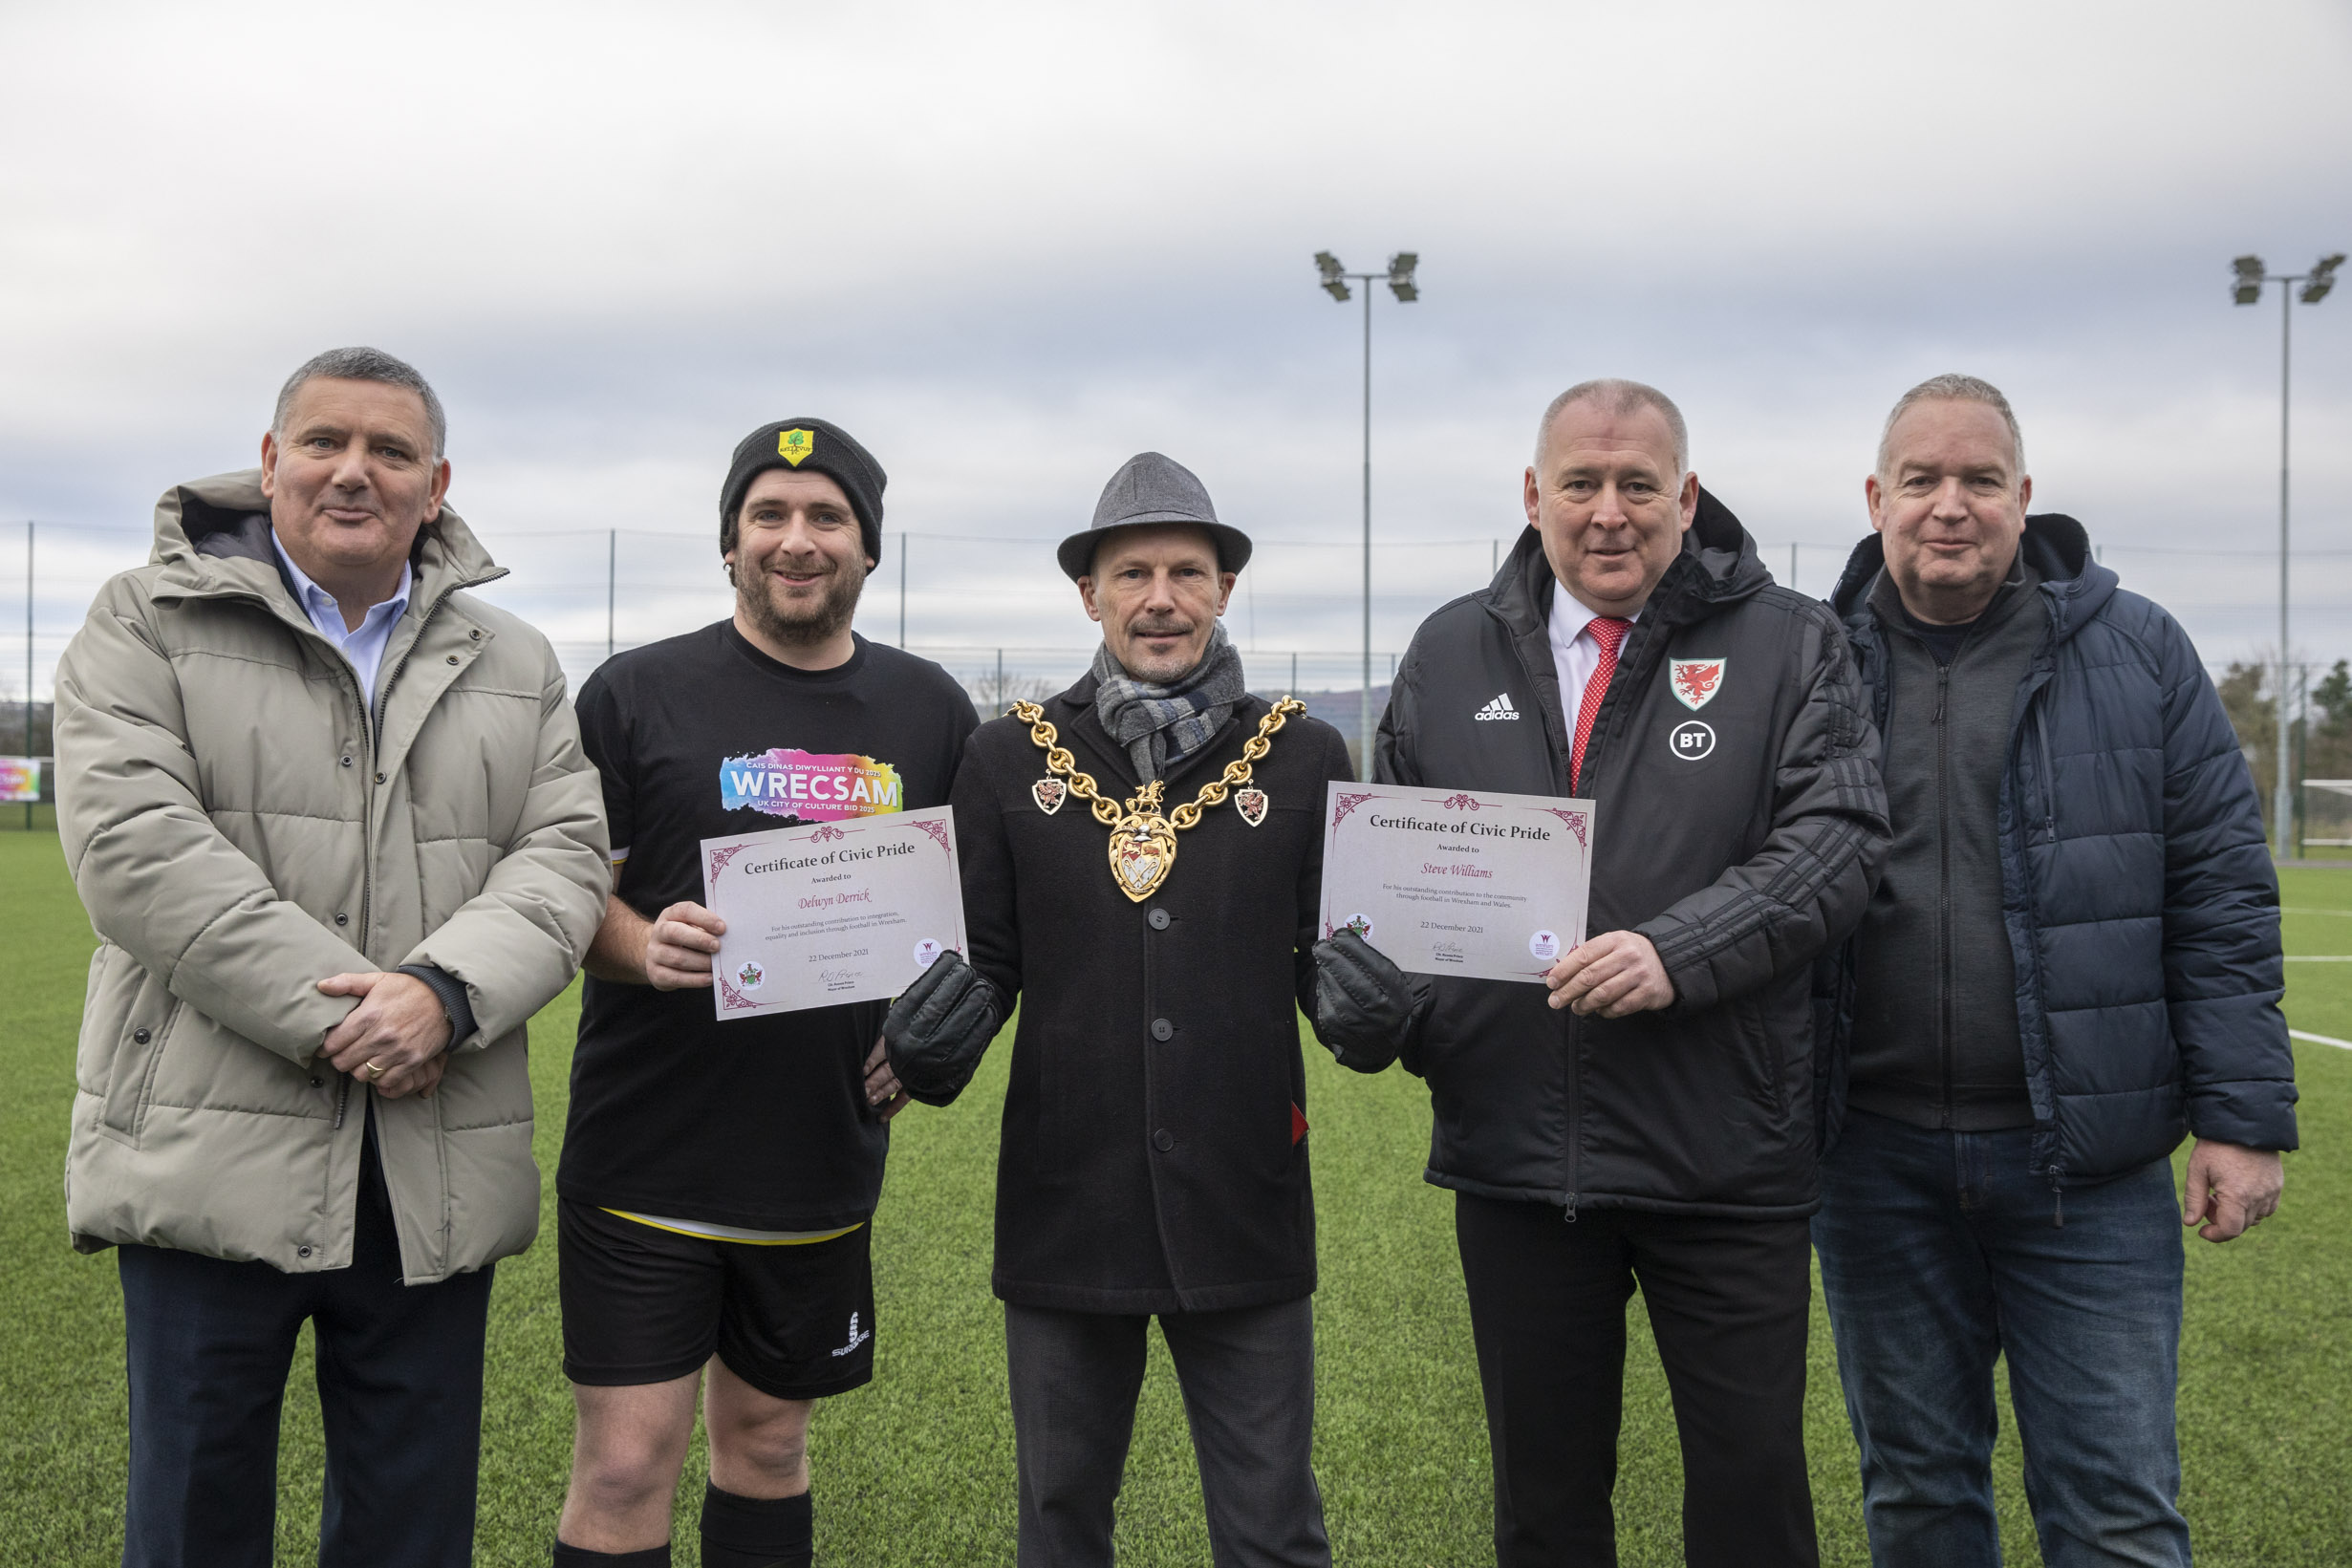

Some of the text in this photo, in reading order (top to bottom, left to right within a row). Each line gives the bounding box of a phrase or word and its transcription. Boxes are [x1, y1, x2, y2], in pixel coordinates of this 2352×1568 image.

[1475, 709, 1519, 721] adidas
[1680, 733, 1705, 748] BT
[796, 765, 845, 773] DIWYLLIANT
[731, 771, 898, 807] WRECSAM
[1370, 815, 1550, 840] Certificate of Civic Pride
[1437, 844, 1469, 853] Awarded
[745, 842, 915, 874] Certificate of Civic Pride
[1421, 863, 1493, 879] Steve Williams
[811, 874, 842, 884] Awarded
[798, 889, 872, 910] Delwyn Derrick
[1396, 892, 1419, 901] through
[1403, 886, 1438, 894] outstanding
[1494, 894, 1526, 902] community
[791, 921, 824, 930] outstanding
[825, 917, 859, 925] contribution
[1431, 922, 1466, 931] December
[765, 932, 787, 941] equality
[849, 922, 870, 930] football
[819, 952, 852, 961] December
